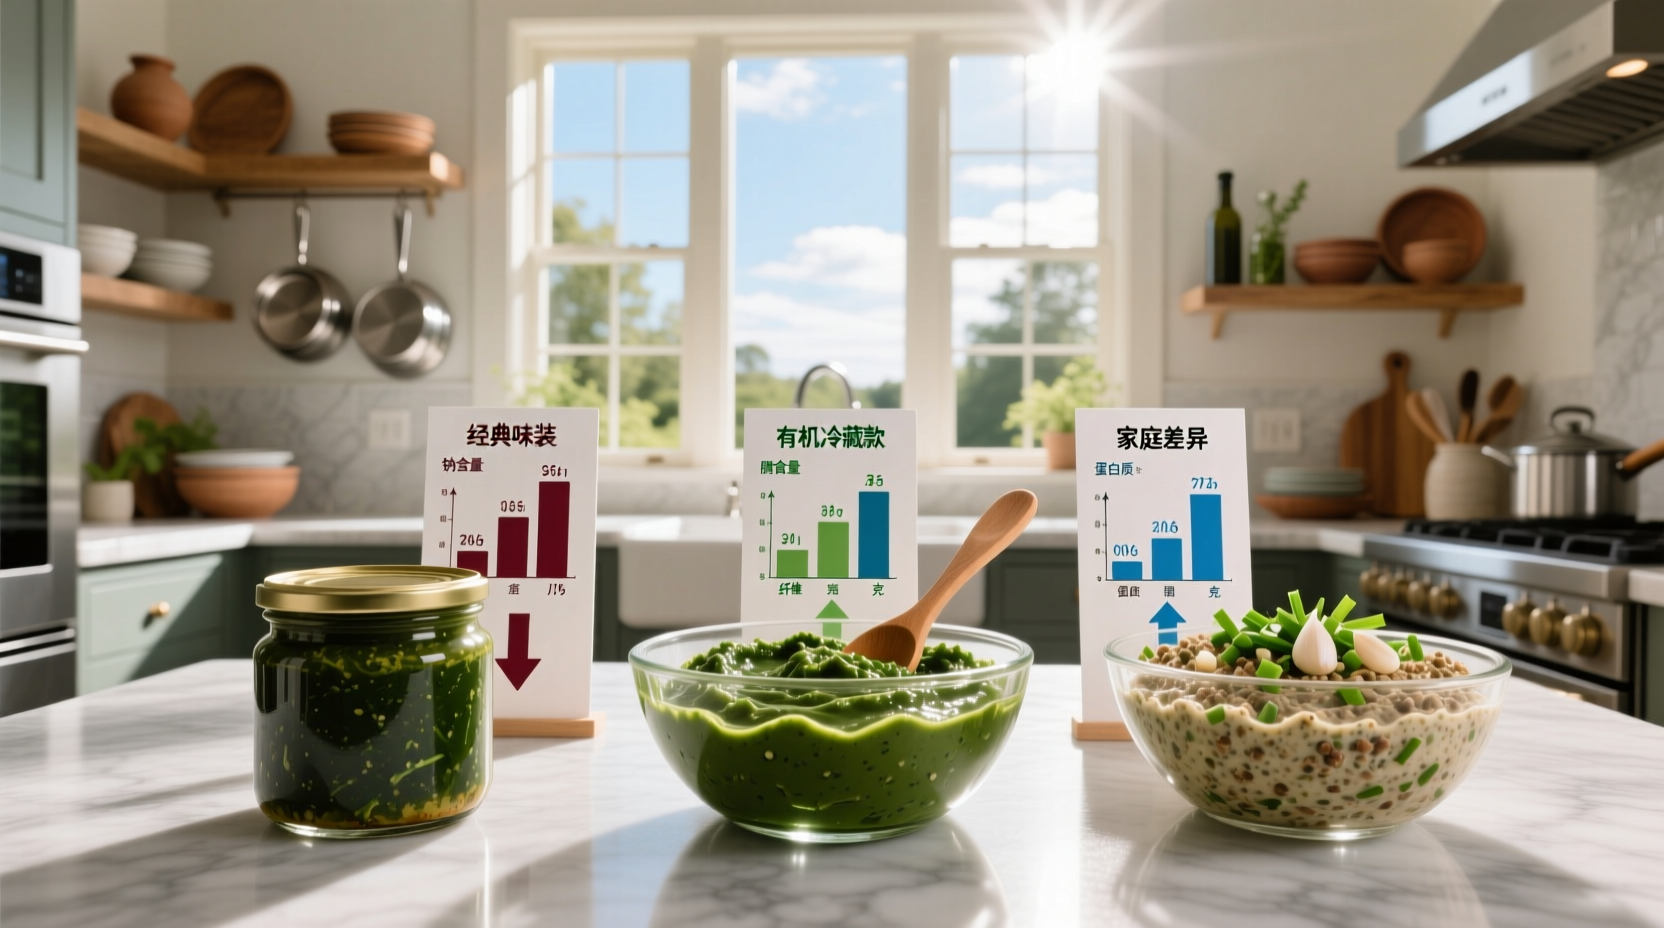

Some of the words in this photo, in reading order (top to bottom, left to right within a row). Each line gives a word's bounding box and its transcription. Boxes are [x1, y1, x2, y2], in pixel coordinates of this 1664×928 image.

[467, 422, 557, 447] 经典味装
[777, 424, 886, 449] 有机冷藏款
[1117, 425, 1208, 451] 家庭差异
